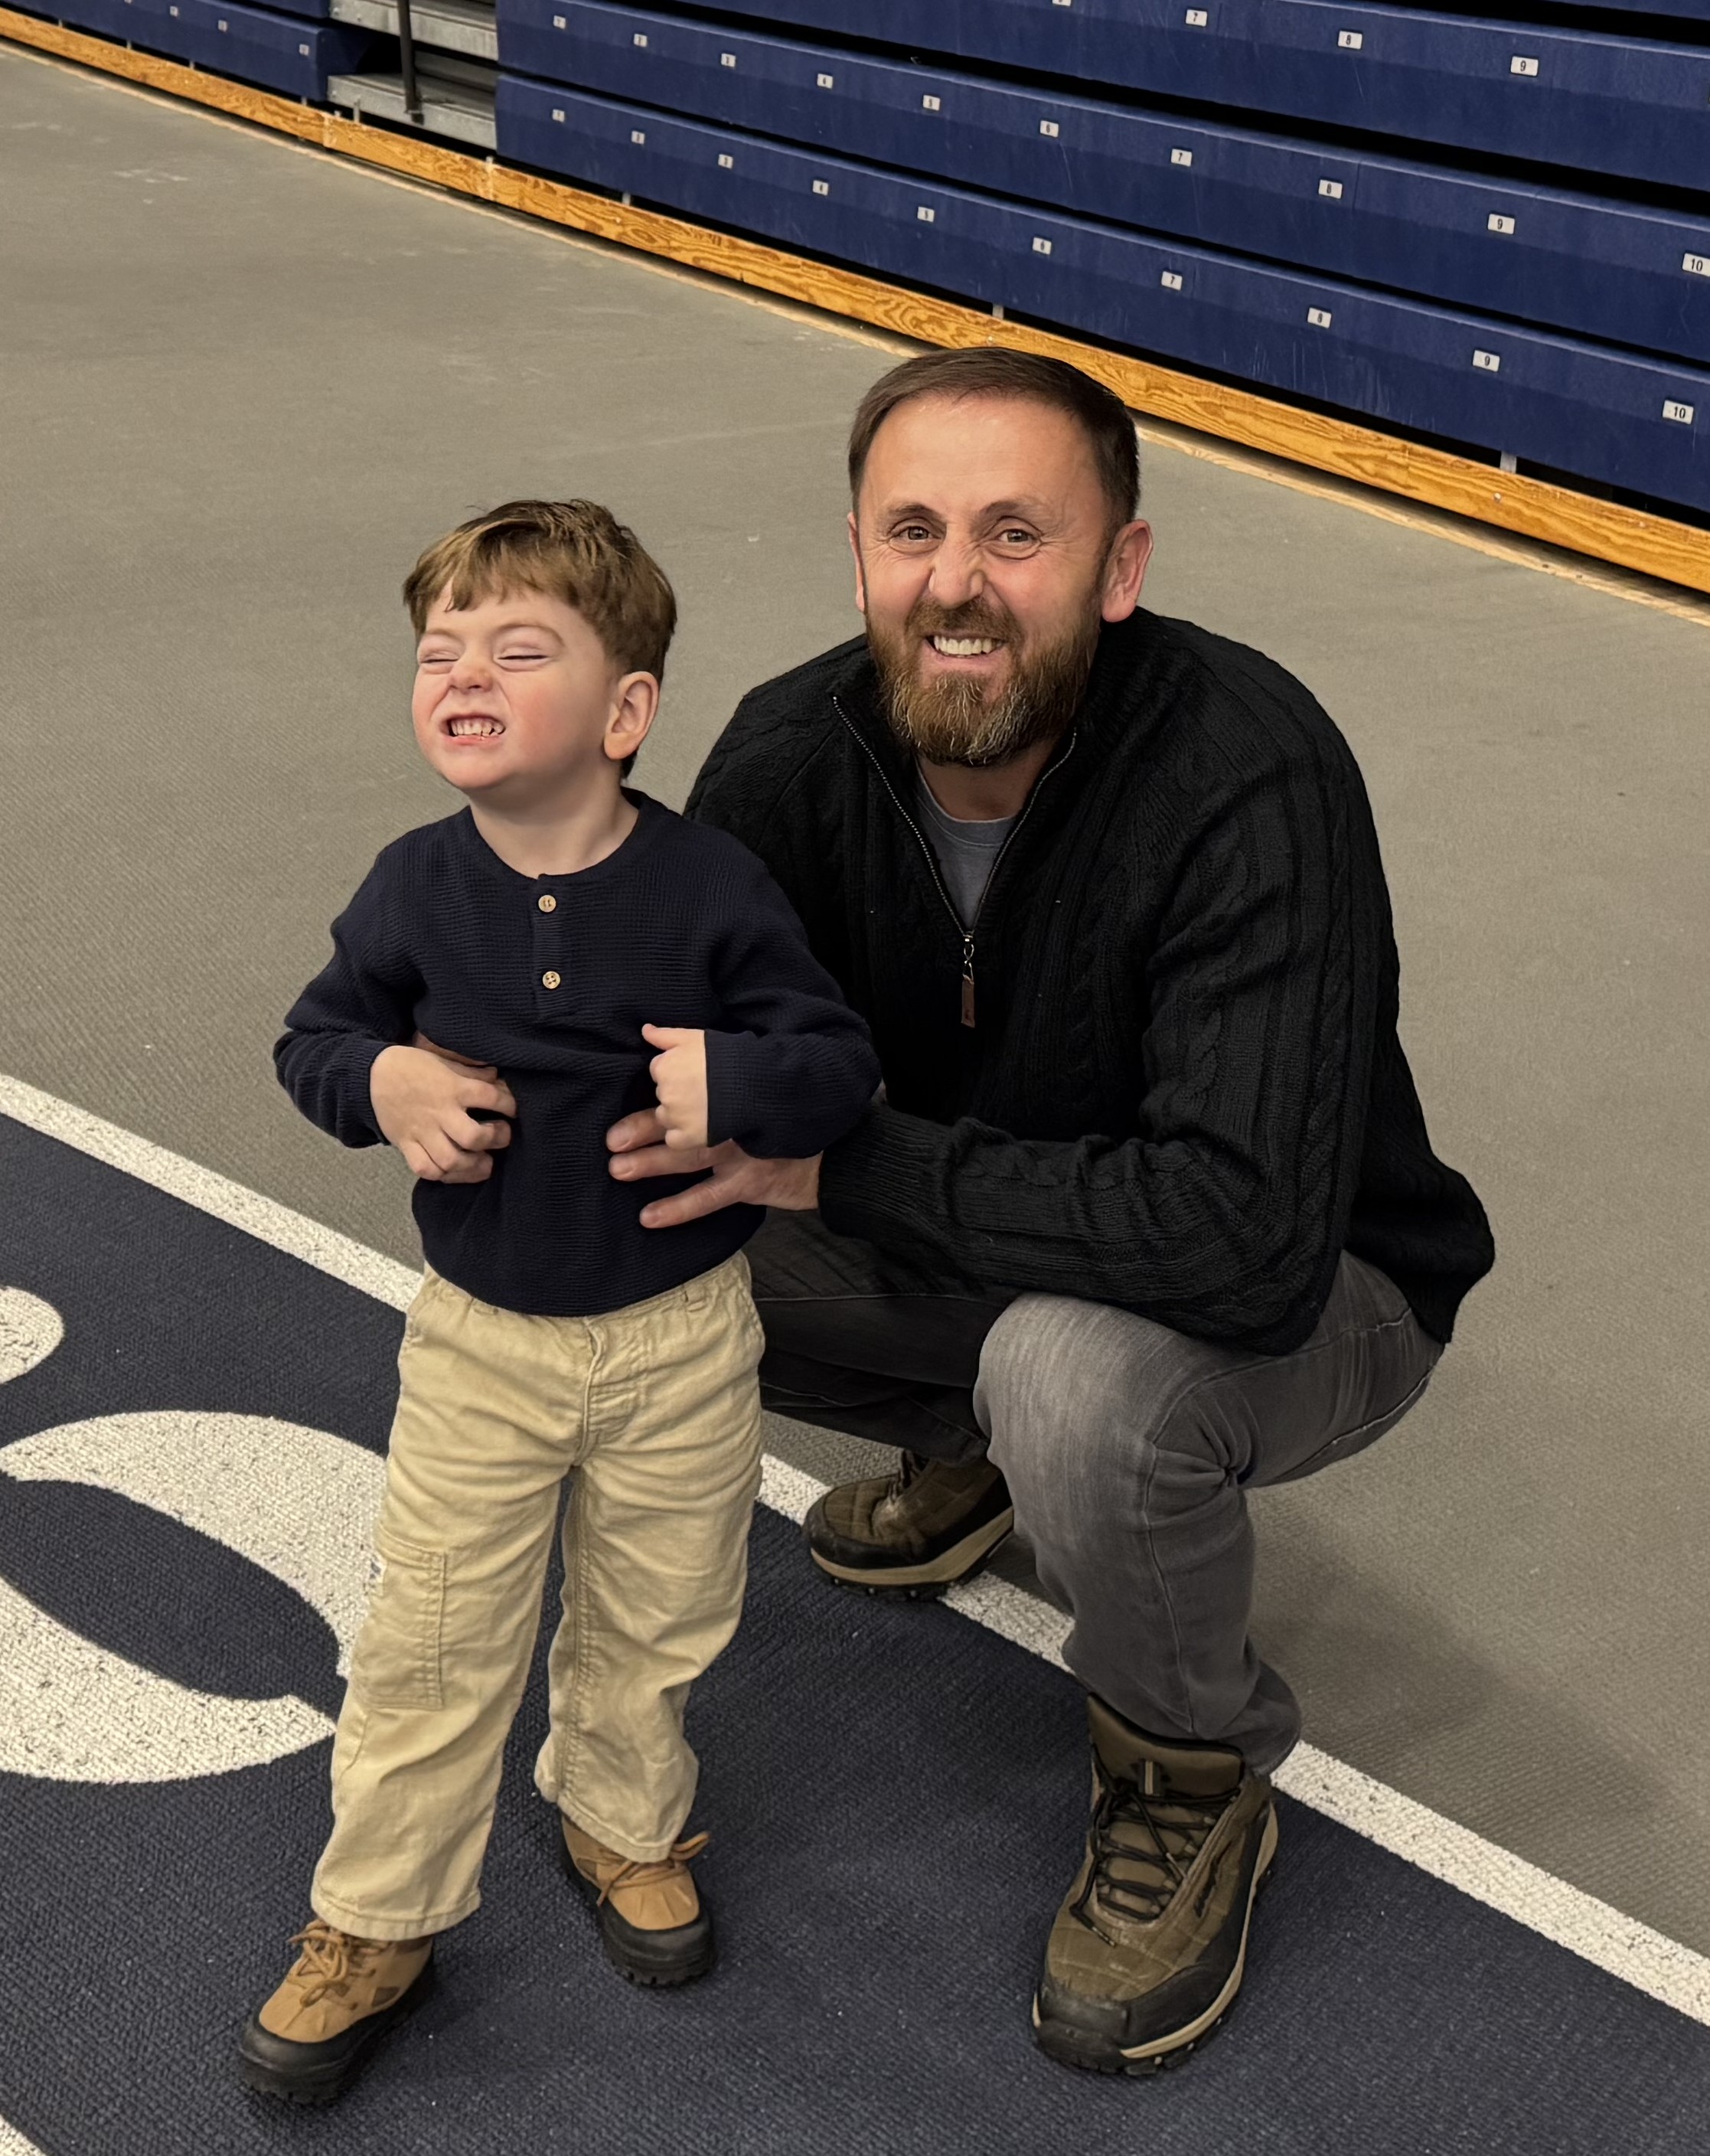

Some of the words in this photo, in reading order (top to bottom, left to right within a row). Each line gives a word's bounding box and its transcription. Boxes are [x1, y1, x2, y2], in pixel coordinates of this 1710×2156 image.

[1193, 11, 1199, 22] 7
[1346, 34, 1352, 45] 8
[1520, 60, 1526, 72] 9
[1178, 152, 1183, 162] 7
[1326, 183, 1332, 194] 8
[1497, 218, 1503, 230] 9
[1691, 258, 1703, 272] 10
[1170, 275, 1176, 285] 7
[1484, 355, 1490, 367] 9
[1674, 406, 1686, 419] 10
